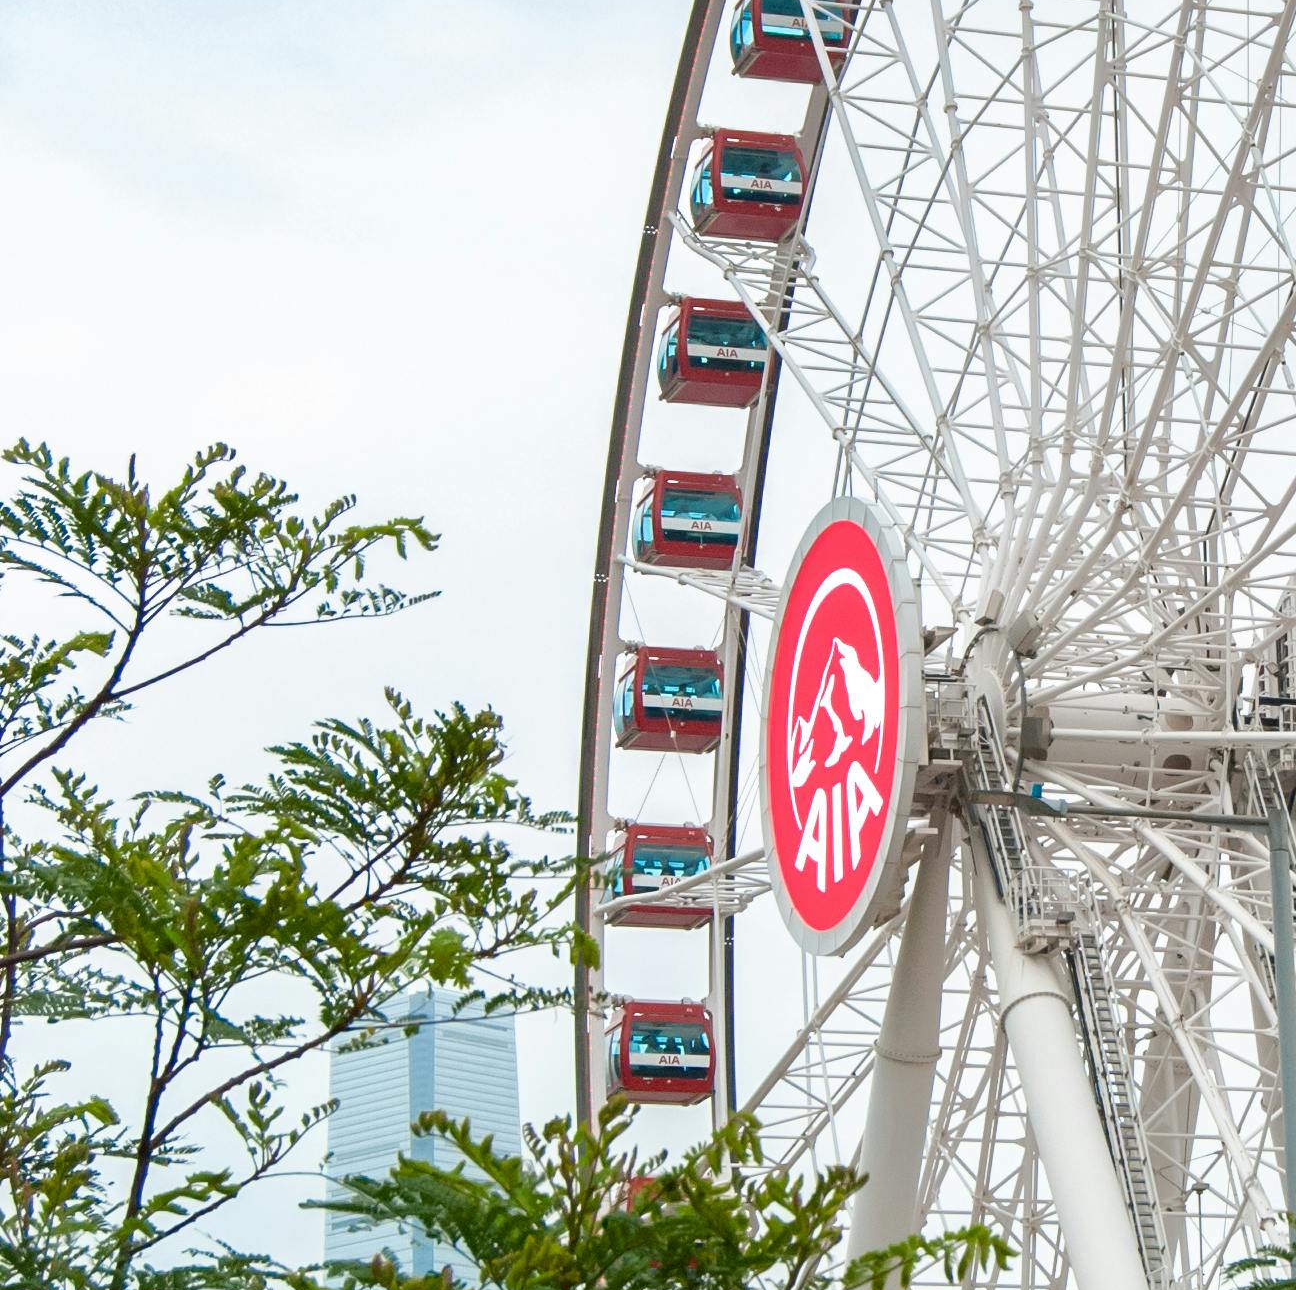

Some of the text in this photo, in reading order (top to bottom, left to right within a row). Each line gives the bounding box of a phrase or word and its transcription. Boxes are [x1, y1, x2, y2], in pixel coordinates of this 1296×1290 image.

[751, 179, 773, 190] AIA
[717, 347, 738, 358] AIA
[691, 521, 712, 532] AIA
[672, 697, 693, 709] AIA
[795, 760, 884, 893] AIA
[659, 1055, 680, 1066] AIA
